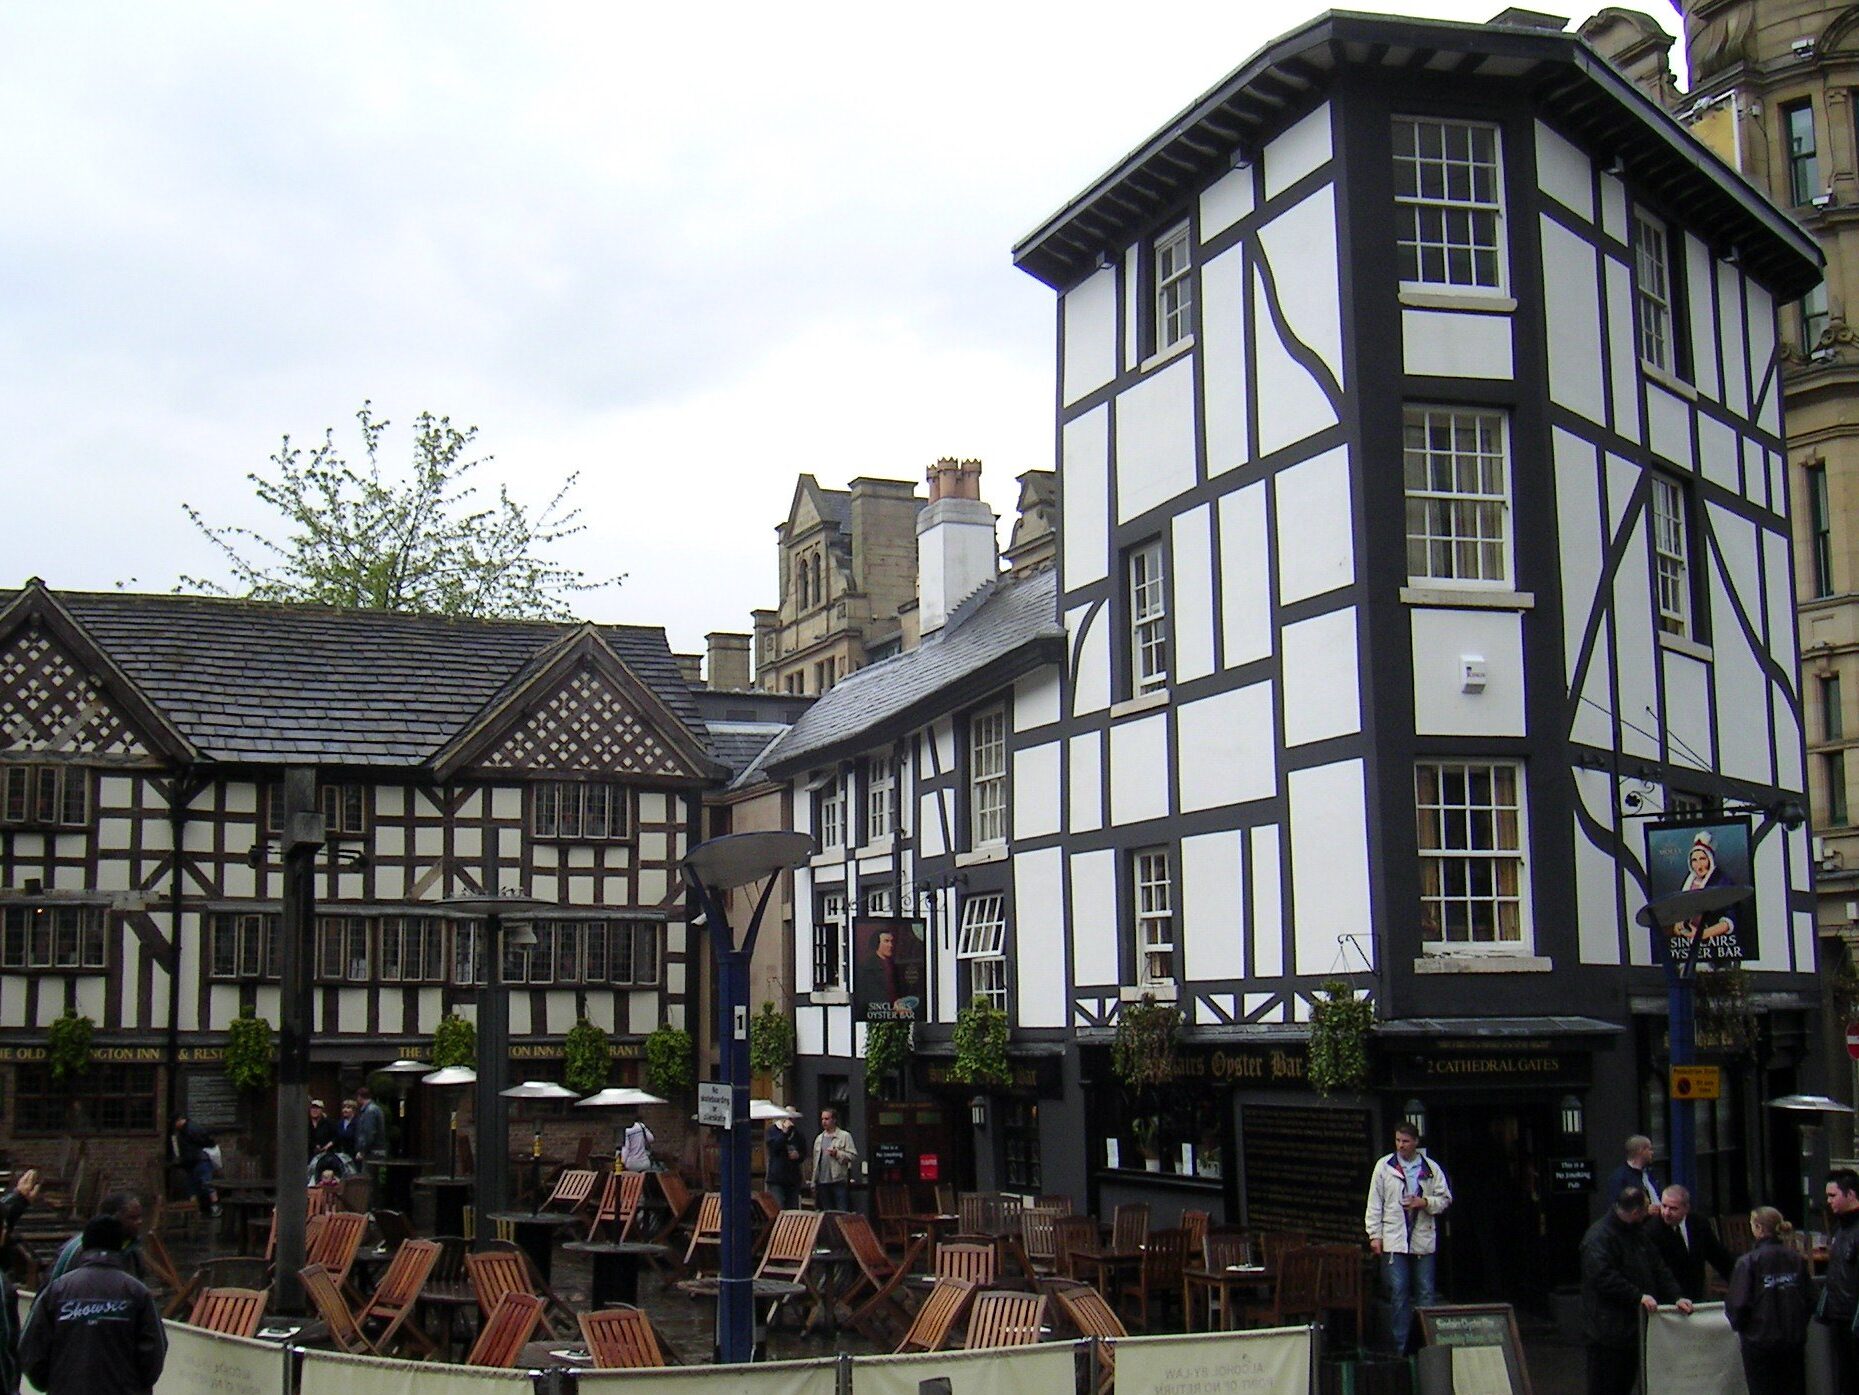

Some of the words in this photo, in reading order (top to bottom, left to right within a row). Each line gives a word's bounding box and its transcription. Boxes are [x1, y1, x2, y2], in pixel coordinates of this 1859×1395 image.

[1717, 947, 1743, 959] BAR
[867, 1010, 897, 1020] OYSTER
[898, 1010, 915, 1020] BAR
[736, 1014, 743, 1031] 1
[16, 1048, 47, 1060] OLD
[135, 1047, 160, 1060] INN
[178, 1048, 190, 1061] &
[399, 1047, 421, 1058] THE
[532, 1046, 554, 1056] INN
[1210, 1051, 1263, 1082] Oyster
[1268, 1049, 1304, 1080] Bar
[1424, 1060, 1434, 1073] 2
[1436, 1058, 1517, 1073] CATHEDRAL
[1518, 1057, 1560, 1072] GATES
